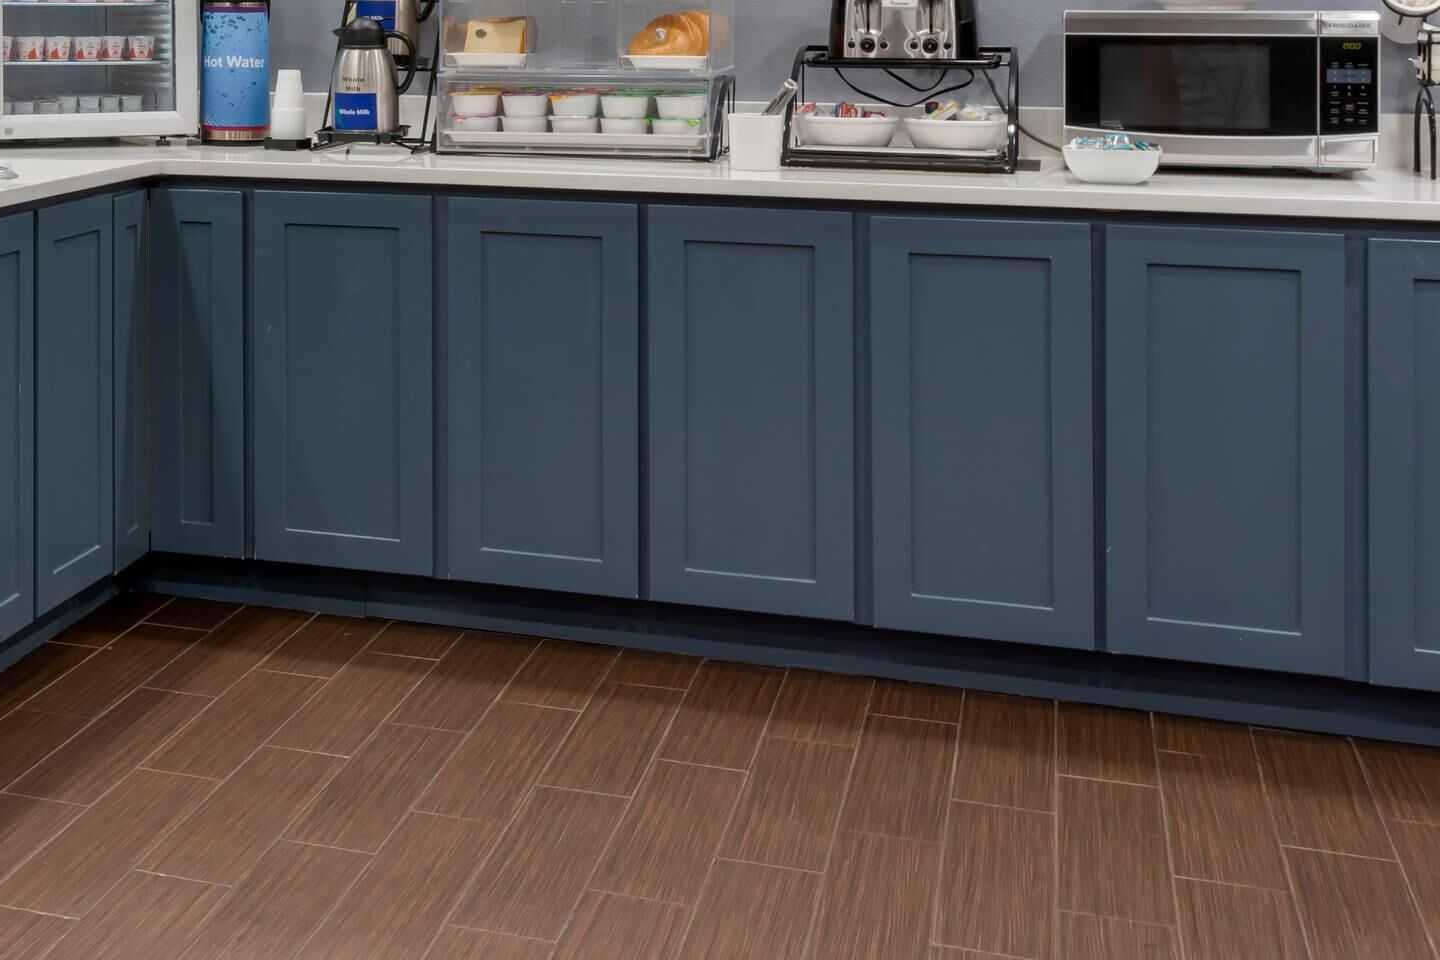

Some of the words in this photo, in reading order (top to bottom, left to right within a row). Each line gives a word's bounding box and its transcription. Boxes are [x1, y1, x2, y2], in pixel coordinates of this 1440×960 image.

[203, 55, 224, 68] Hot
[226, 55, 265, 68] Water
[339, 108, 356, 116] Whole
[356, 108, 371, 116] Milk
